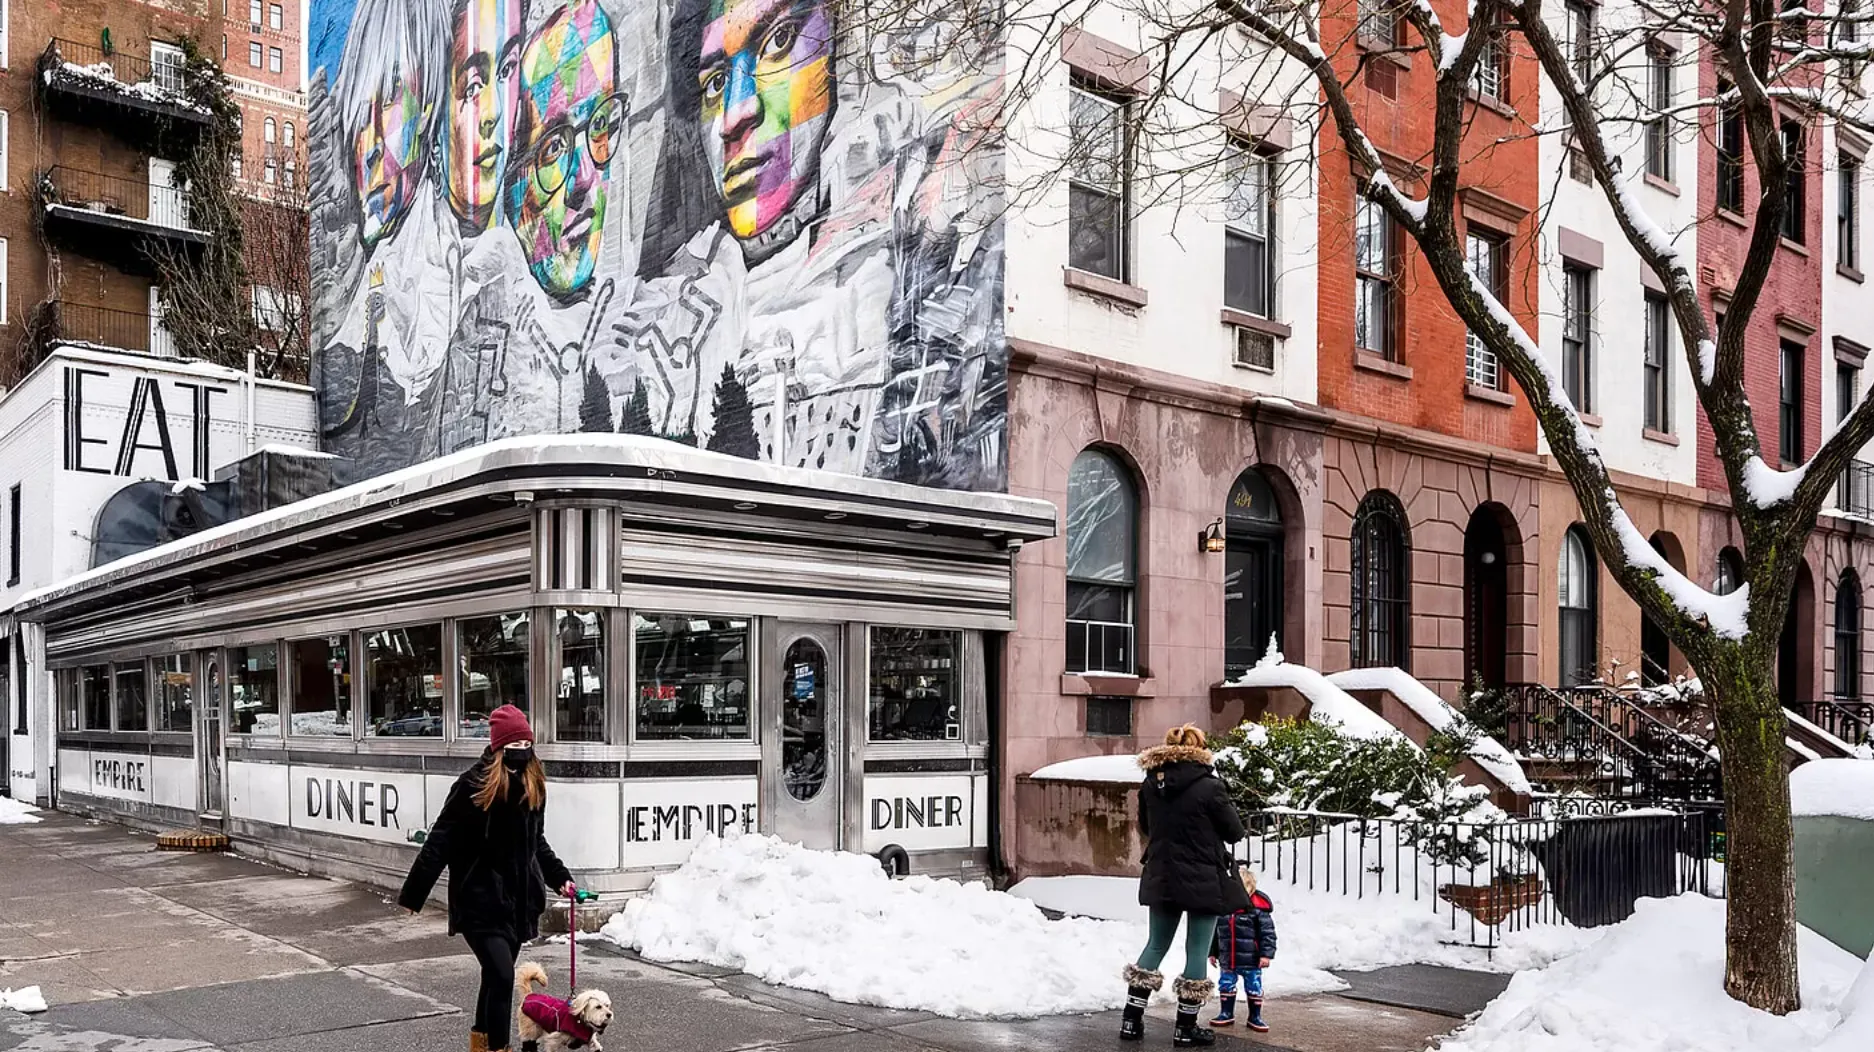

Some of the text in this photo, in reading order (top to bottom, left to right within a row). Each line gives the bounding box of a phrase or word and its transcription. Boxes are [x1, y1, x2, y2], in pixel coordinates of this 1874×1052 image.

[64, 366, 228, 482] EAT
[95, 759, 145, 792] EMPIRE
[306, 777, 400, 830] DINER
[871, 796, 962, 830] DINER
